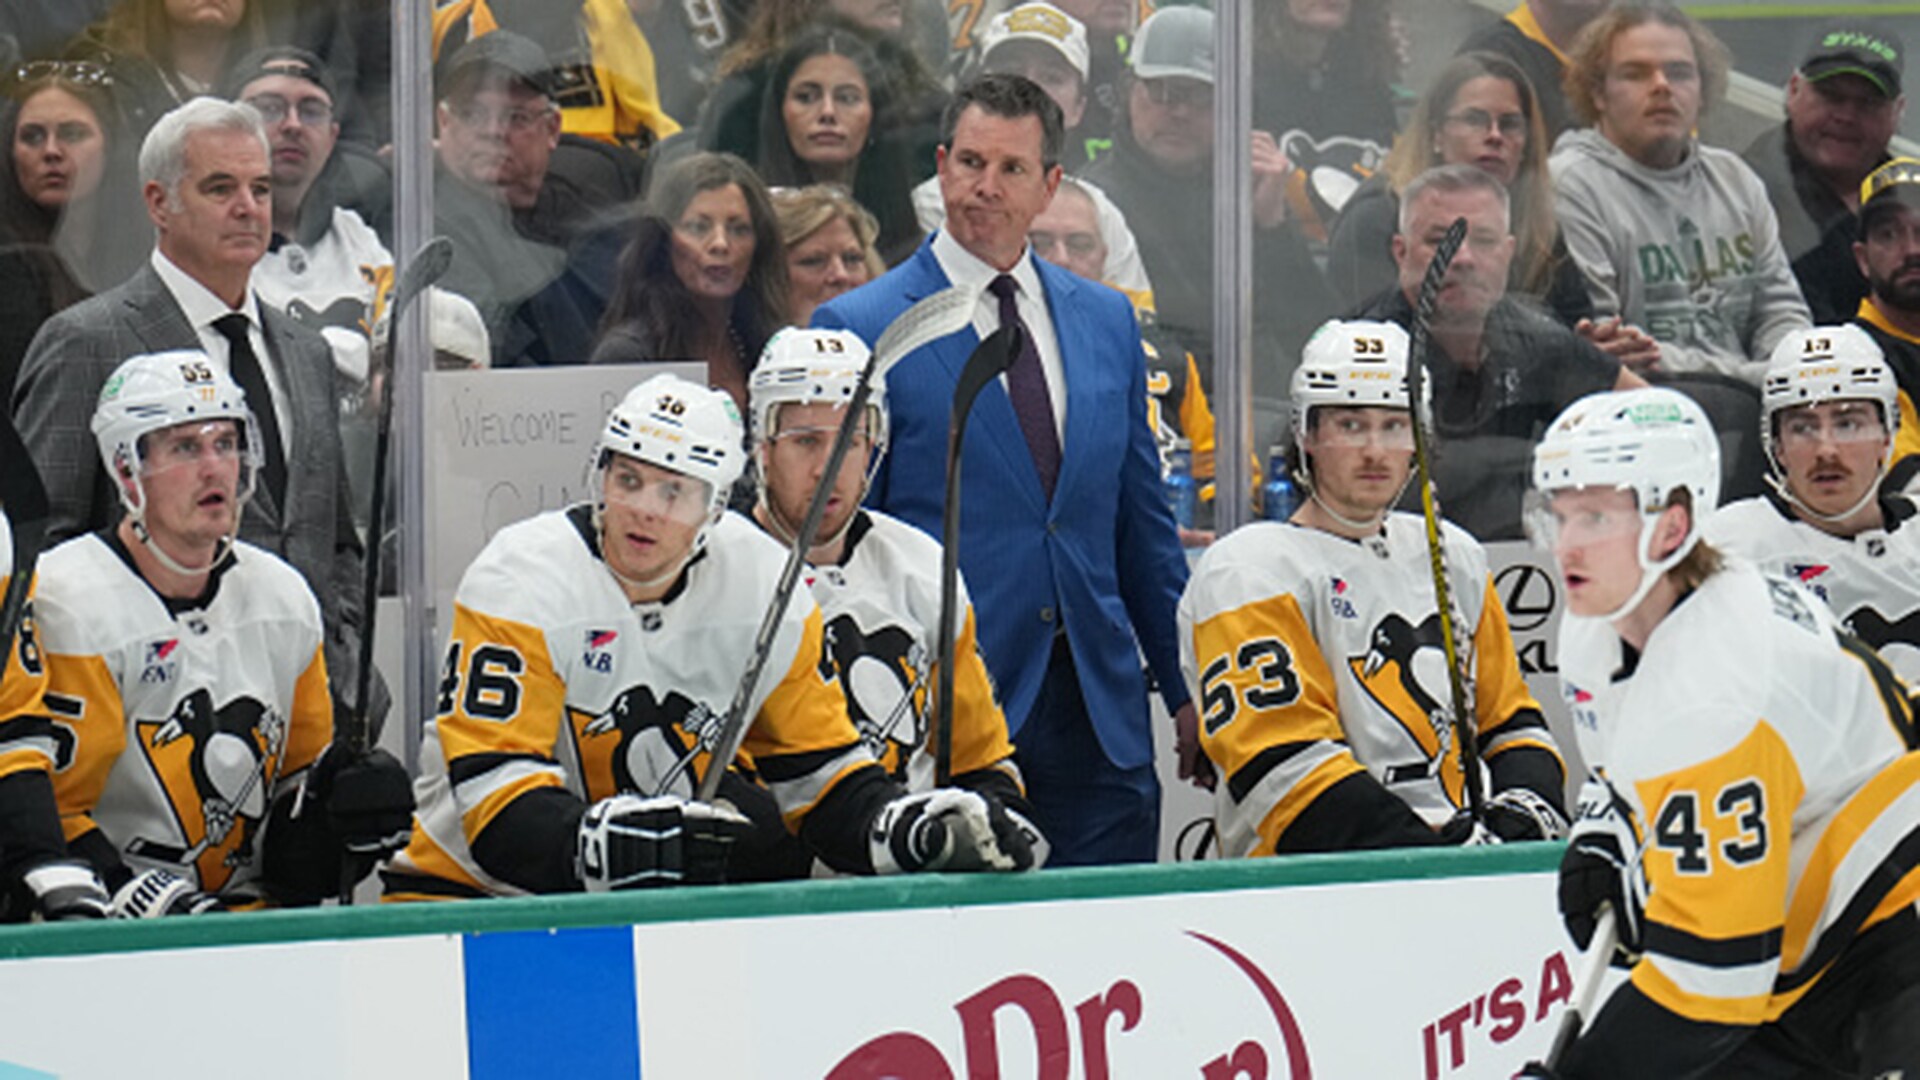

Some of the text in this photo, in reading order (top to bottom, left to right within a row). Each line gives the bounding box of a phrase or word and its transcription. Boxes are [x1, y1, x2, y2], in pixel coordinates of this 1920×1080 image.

[1639, 232, 1755, 285] DALAS
[451, 396, 578, 447] WELCOME
[434, 641, 524, 721] 46
[1199, 637, 1302, 736] 53
[1654, 779, 1769, 873] 43
[1422, 950, 1574, 1080] IT'S A
